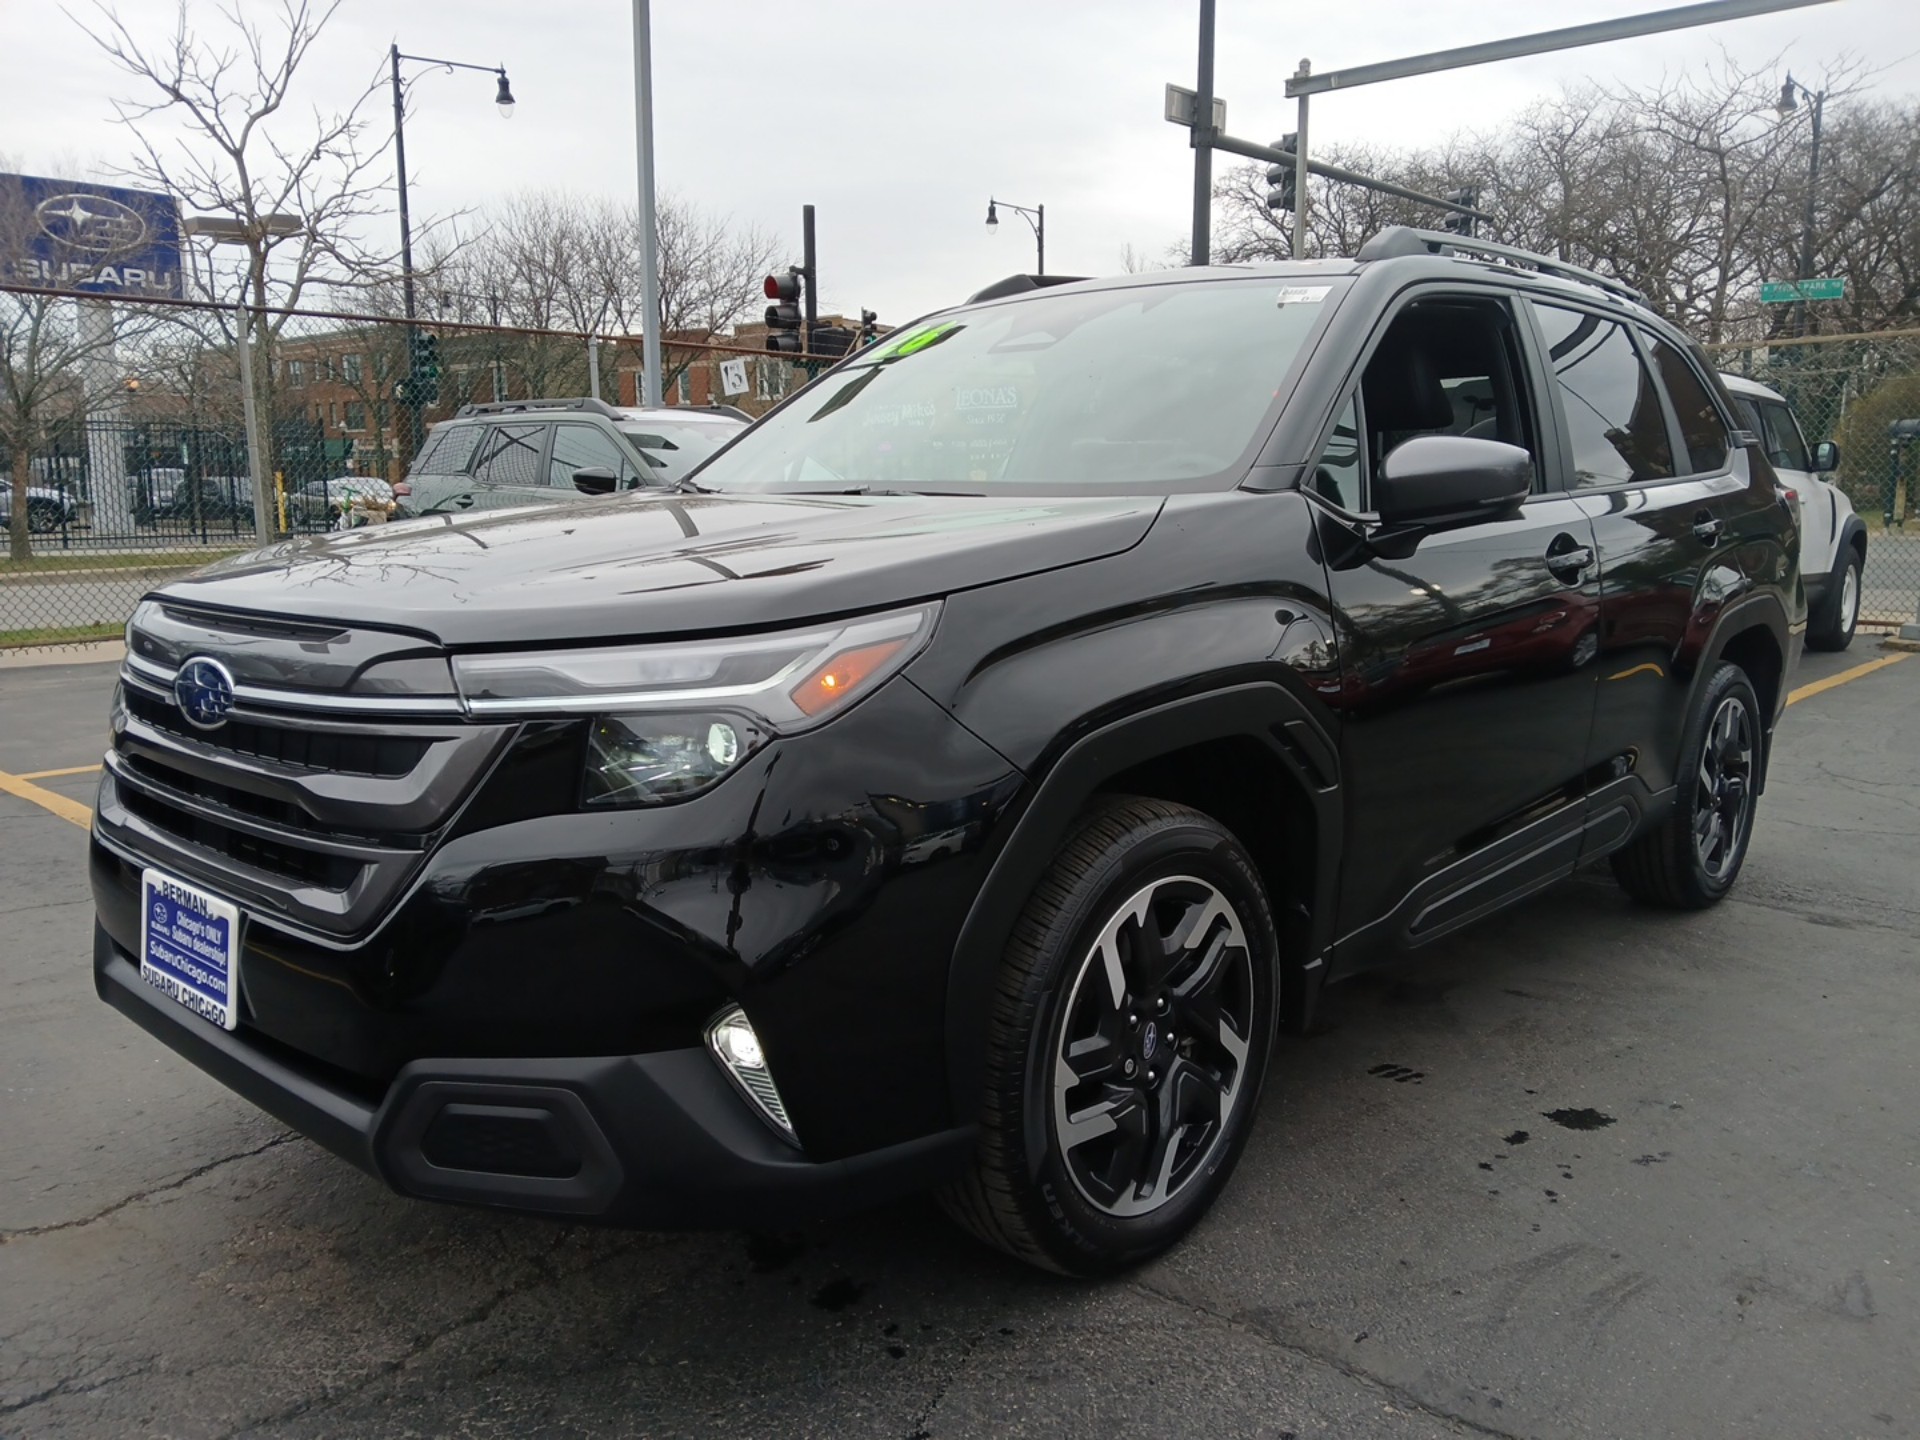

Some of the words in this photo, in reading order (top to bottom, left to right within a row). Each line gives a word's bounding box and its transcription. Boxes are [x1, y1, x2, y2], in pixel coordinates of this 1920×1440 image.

[13, 257, 172, 291] SUBARU
[955, 386, 1018, 410] LEONA'S
[162, 880, 208, 917] BERMAN
[172, 925, 193, 948] Subaru
[176, 910, 205, 938] Chicago's
[205, 924, 222, 945] ONLY
[150, 940, 227, 995] SubaruChicago.com
[142, 964, 180, 1000] SUBARU
[181, 987, 227, 1027] CHICAGO
